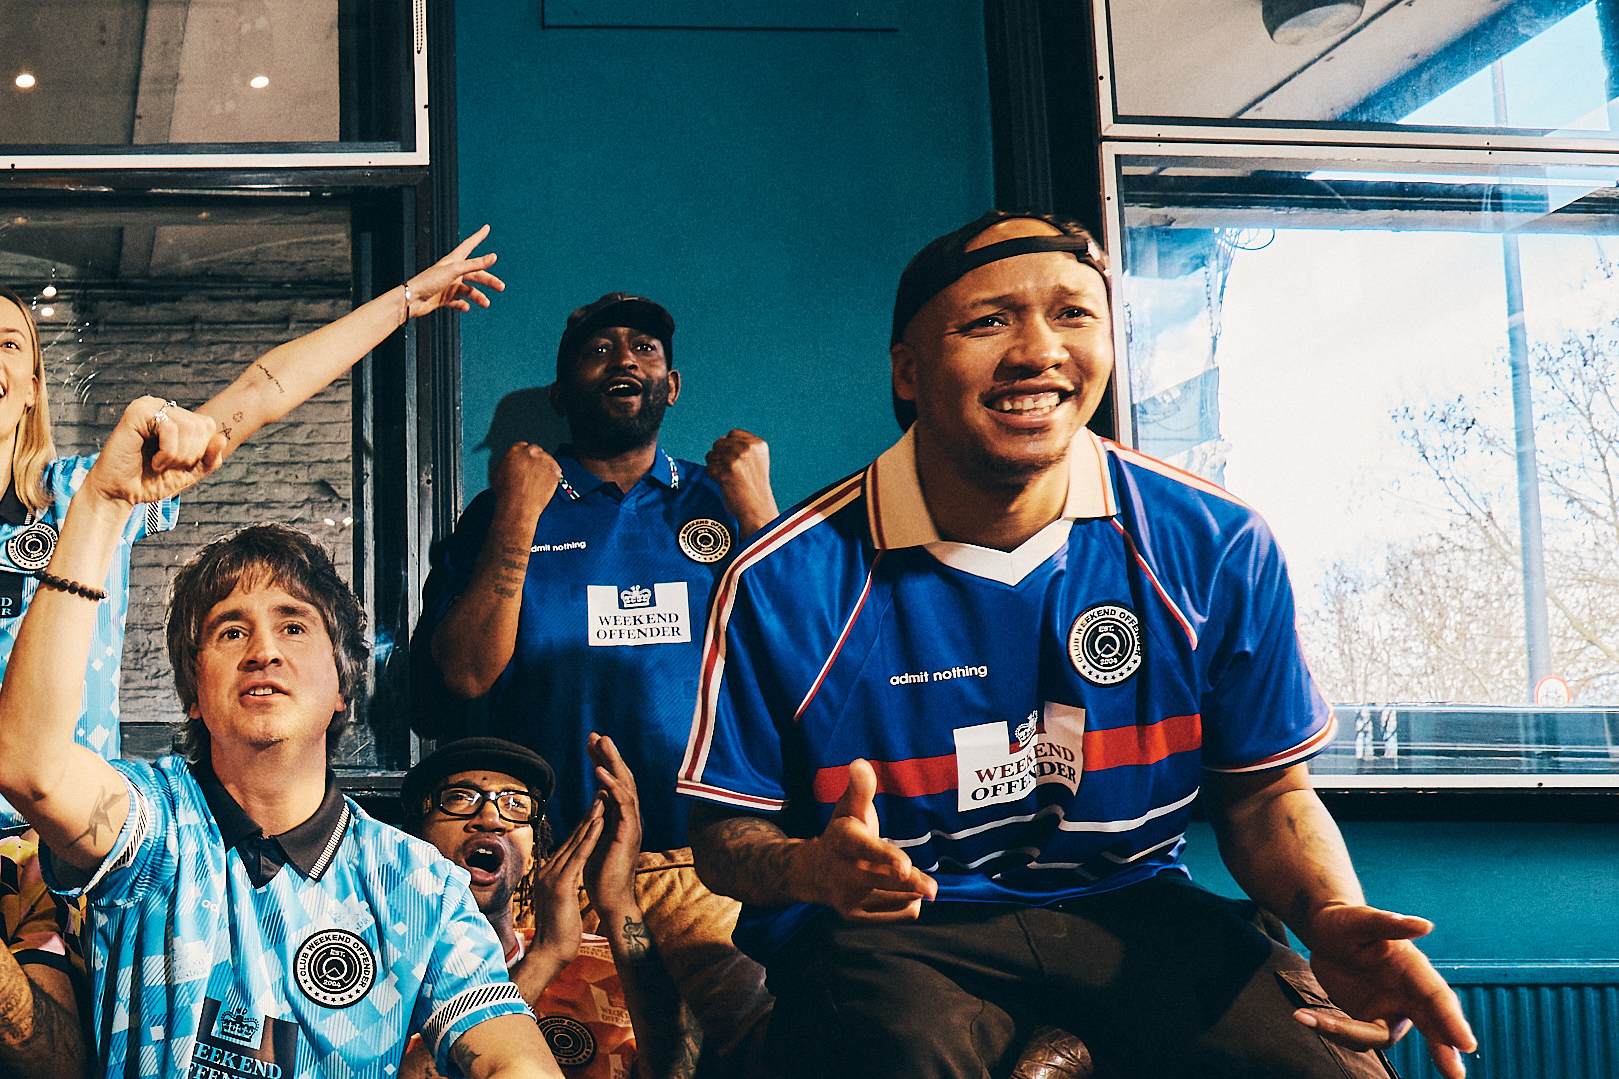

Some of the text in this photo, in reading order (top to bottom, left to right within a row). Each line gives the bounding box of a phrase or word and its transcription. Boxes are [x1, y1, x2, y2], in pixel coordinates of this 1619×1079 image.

[530, 541, 587, 553] dmit nothing
[598, 612, 680, 626] WEEKEND
[1075, 608, 1117, 635] WEEKEND
[596, 626, 682, 640] OFFENDER
[889, 664, 988, 686] admit nothing
[299, 934, 371, 988] CLUB WEEKEND OFFENDER
[322, 979, 342, 989] 2004
[193, 1040, 282, 1079] EEKEND
